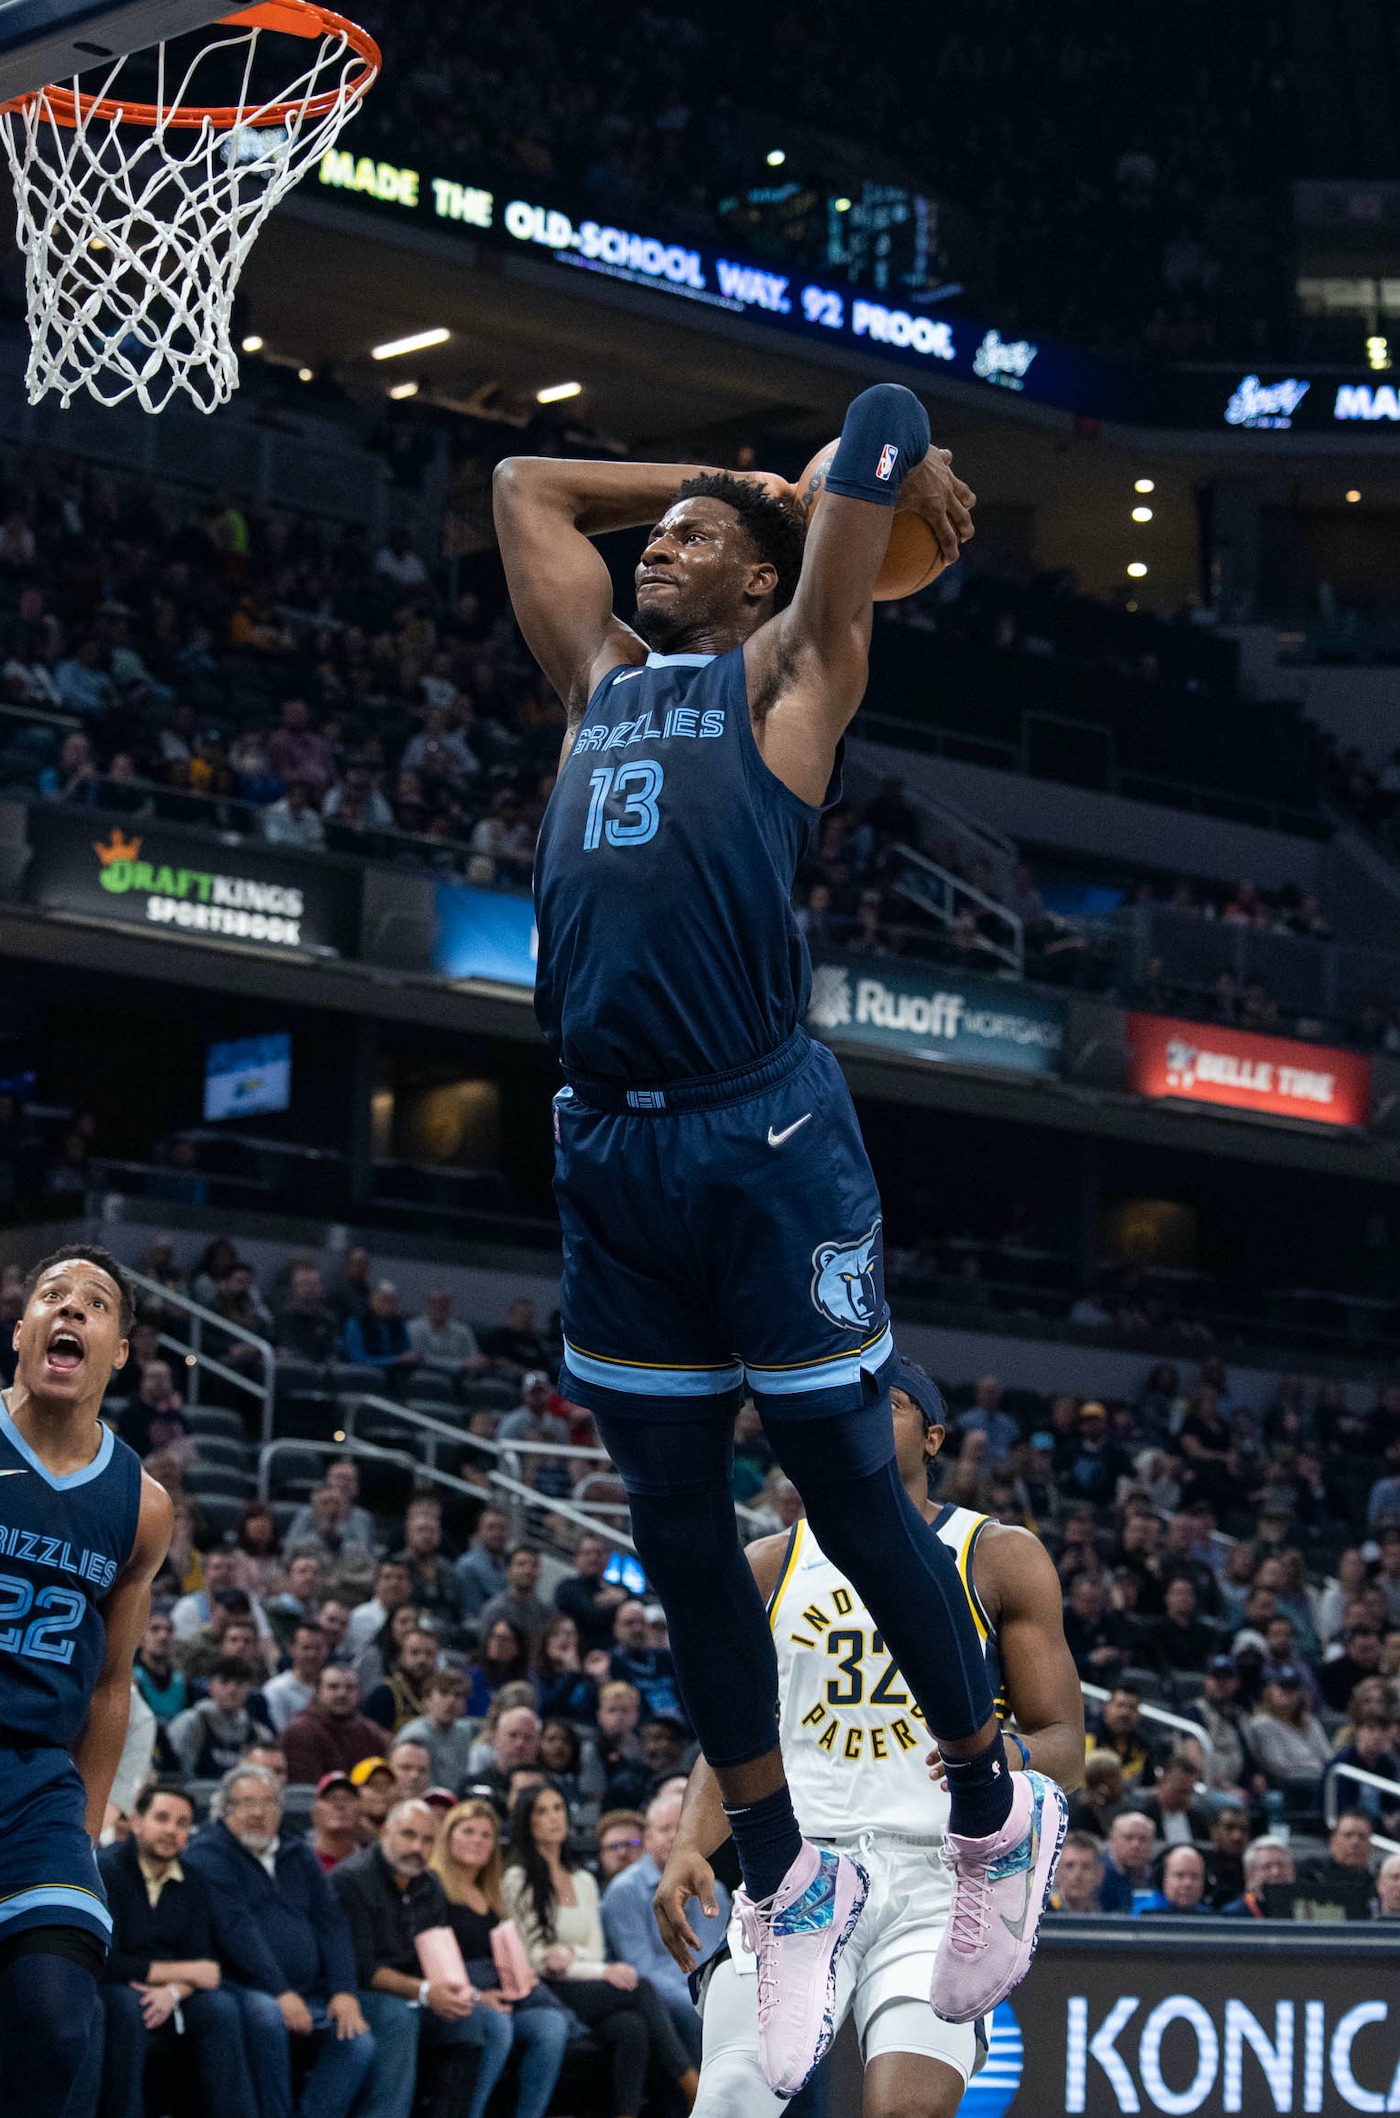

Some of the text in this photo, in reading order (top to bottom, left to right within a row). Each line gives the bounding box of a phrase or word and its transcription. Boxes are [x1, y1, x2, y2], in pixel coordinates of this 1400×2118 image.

[319, 149, 419, 208] MADE
[432, 177, 493, 228] THE
[505, 200, 706, 290] OLD-SCHOOL
[716, 258, 792, 314] WAY.
[801, 285, 844, 329] 92
[1334, 384, 1400, 421] MA
[572, 707, 725, 756] GRIZZLIES
[583, 760, 664, 851] 13
[100, 859, 304, 918] DRAFTKINGS
[147, 896, 300, 946] SPORTSBOOK
[856, 980, 963, 1039] Ruoff
[1197, 1052, 1273, 1092] BELLE
[0, 1574, 87, 1665] 22
[826, 1628, 908, 1707] 32
[1065, 1995, 1400, 2115] KONIC
